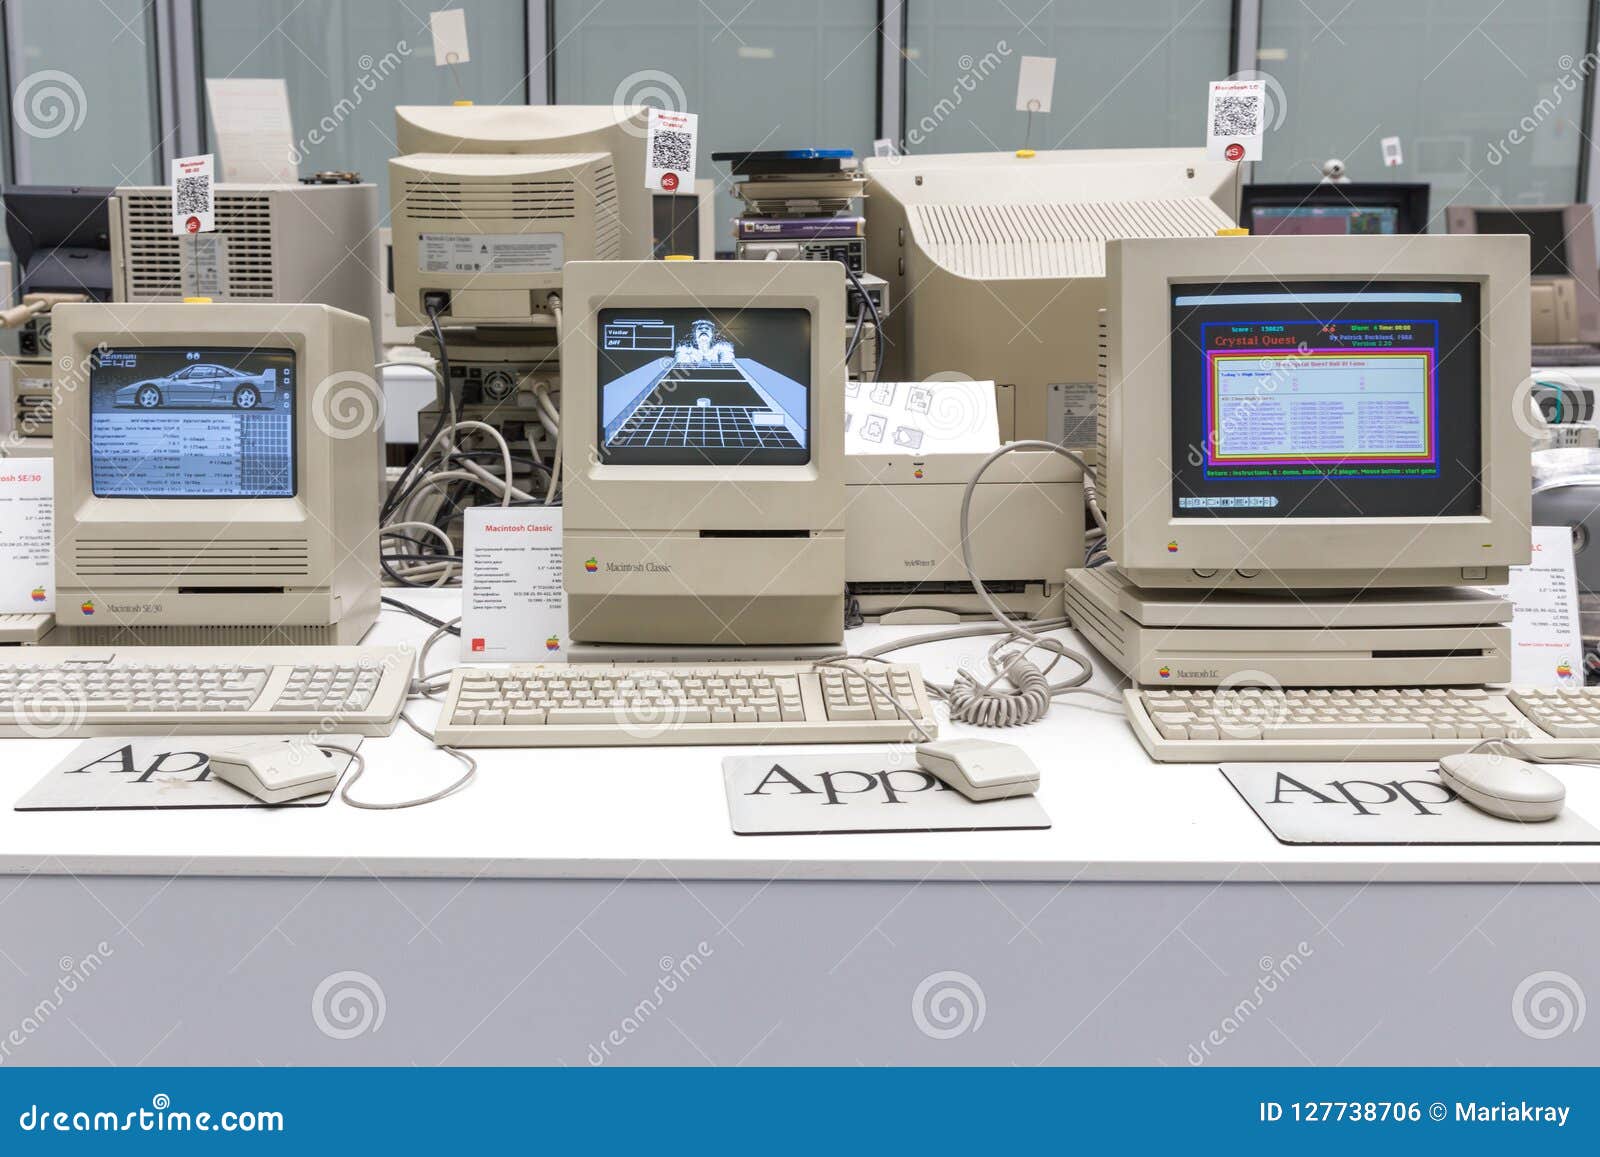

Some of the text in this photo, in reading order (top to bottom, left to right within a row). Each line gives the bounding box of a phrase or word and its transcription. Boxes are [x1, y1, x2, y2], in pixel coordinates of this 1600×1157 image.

[1215, 335, 1297, 348] Crystal Quest
[100, 360, 137, 368] F40
[18, 474, 41, 482] SE/30
[606, 562, 672, 573] Macintosh Classic
[106, 604, 141, 613] Macintosh
[1176, 669, 1208, 678] Macintosh
[744, 763, 951, 805] App
[1265, 769, 1459, 815] App
